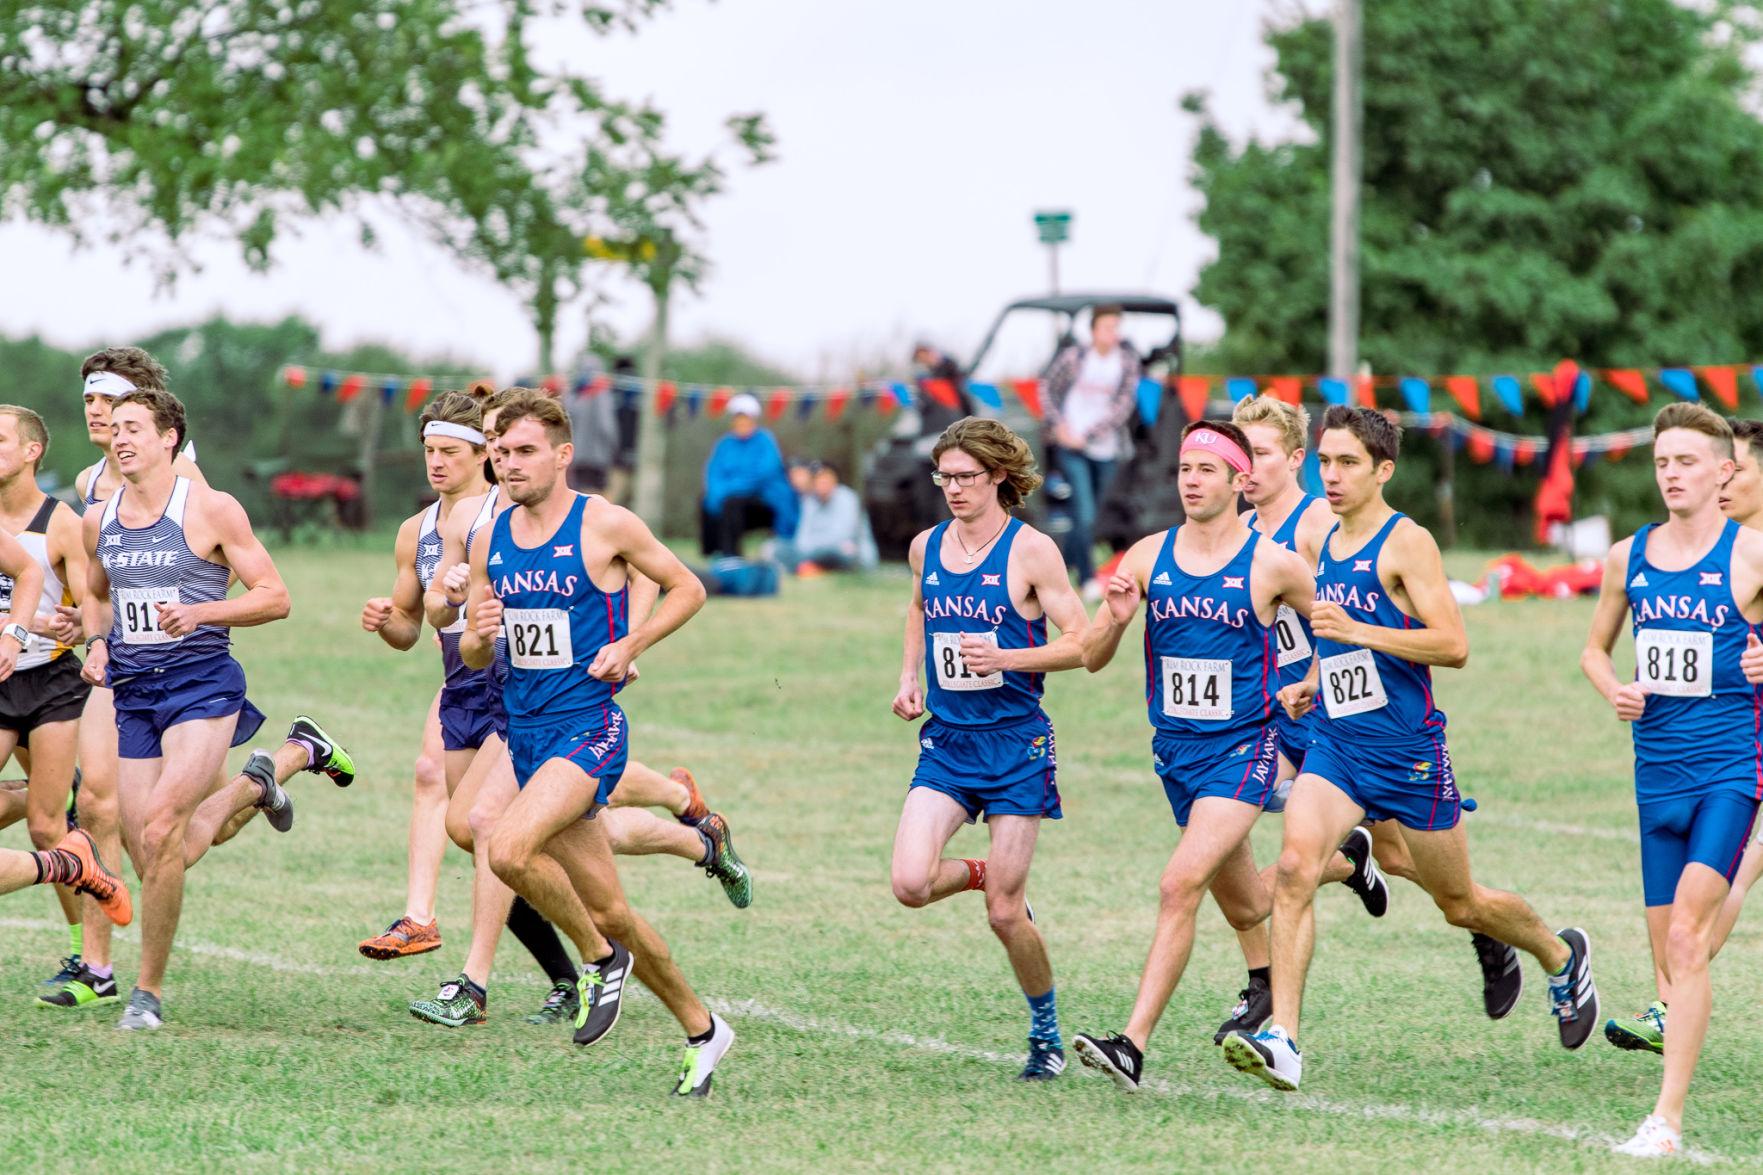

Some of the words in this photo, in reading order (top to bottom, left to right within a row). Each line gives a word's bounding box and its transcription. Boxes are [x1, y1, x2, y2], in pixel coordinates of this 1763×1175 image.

[1195, 432, 1217, 445] KU
[102, 550, 179, 569] K-STATE
[923, 595, 1006, 625] KANSAS
[1150, 596, 1249, 628] KANSAS
[1316, 583, 1379, 612] ANSAS
[514, 623, 560, 657] 821
[942, 647, 989, 678] 81
[1180, 660, 1201, 672] ROCK
[1203, 661, 1226, 673] FARM
[1647, 646, 1698, 683] 818
[1172, 672, 1220, 707] 814
[1329, 666, 1374, 704] 822
[1252, 727, 1279, 785] JAYHAWK
[1441, 743, 1455, 801] AYHAWK
